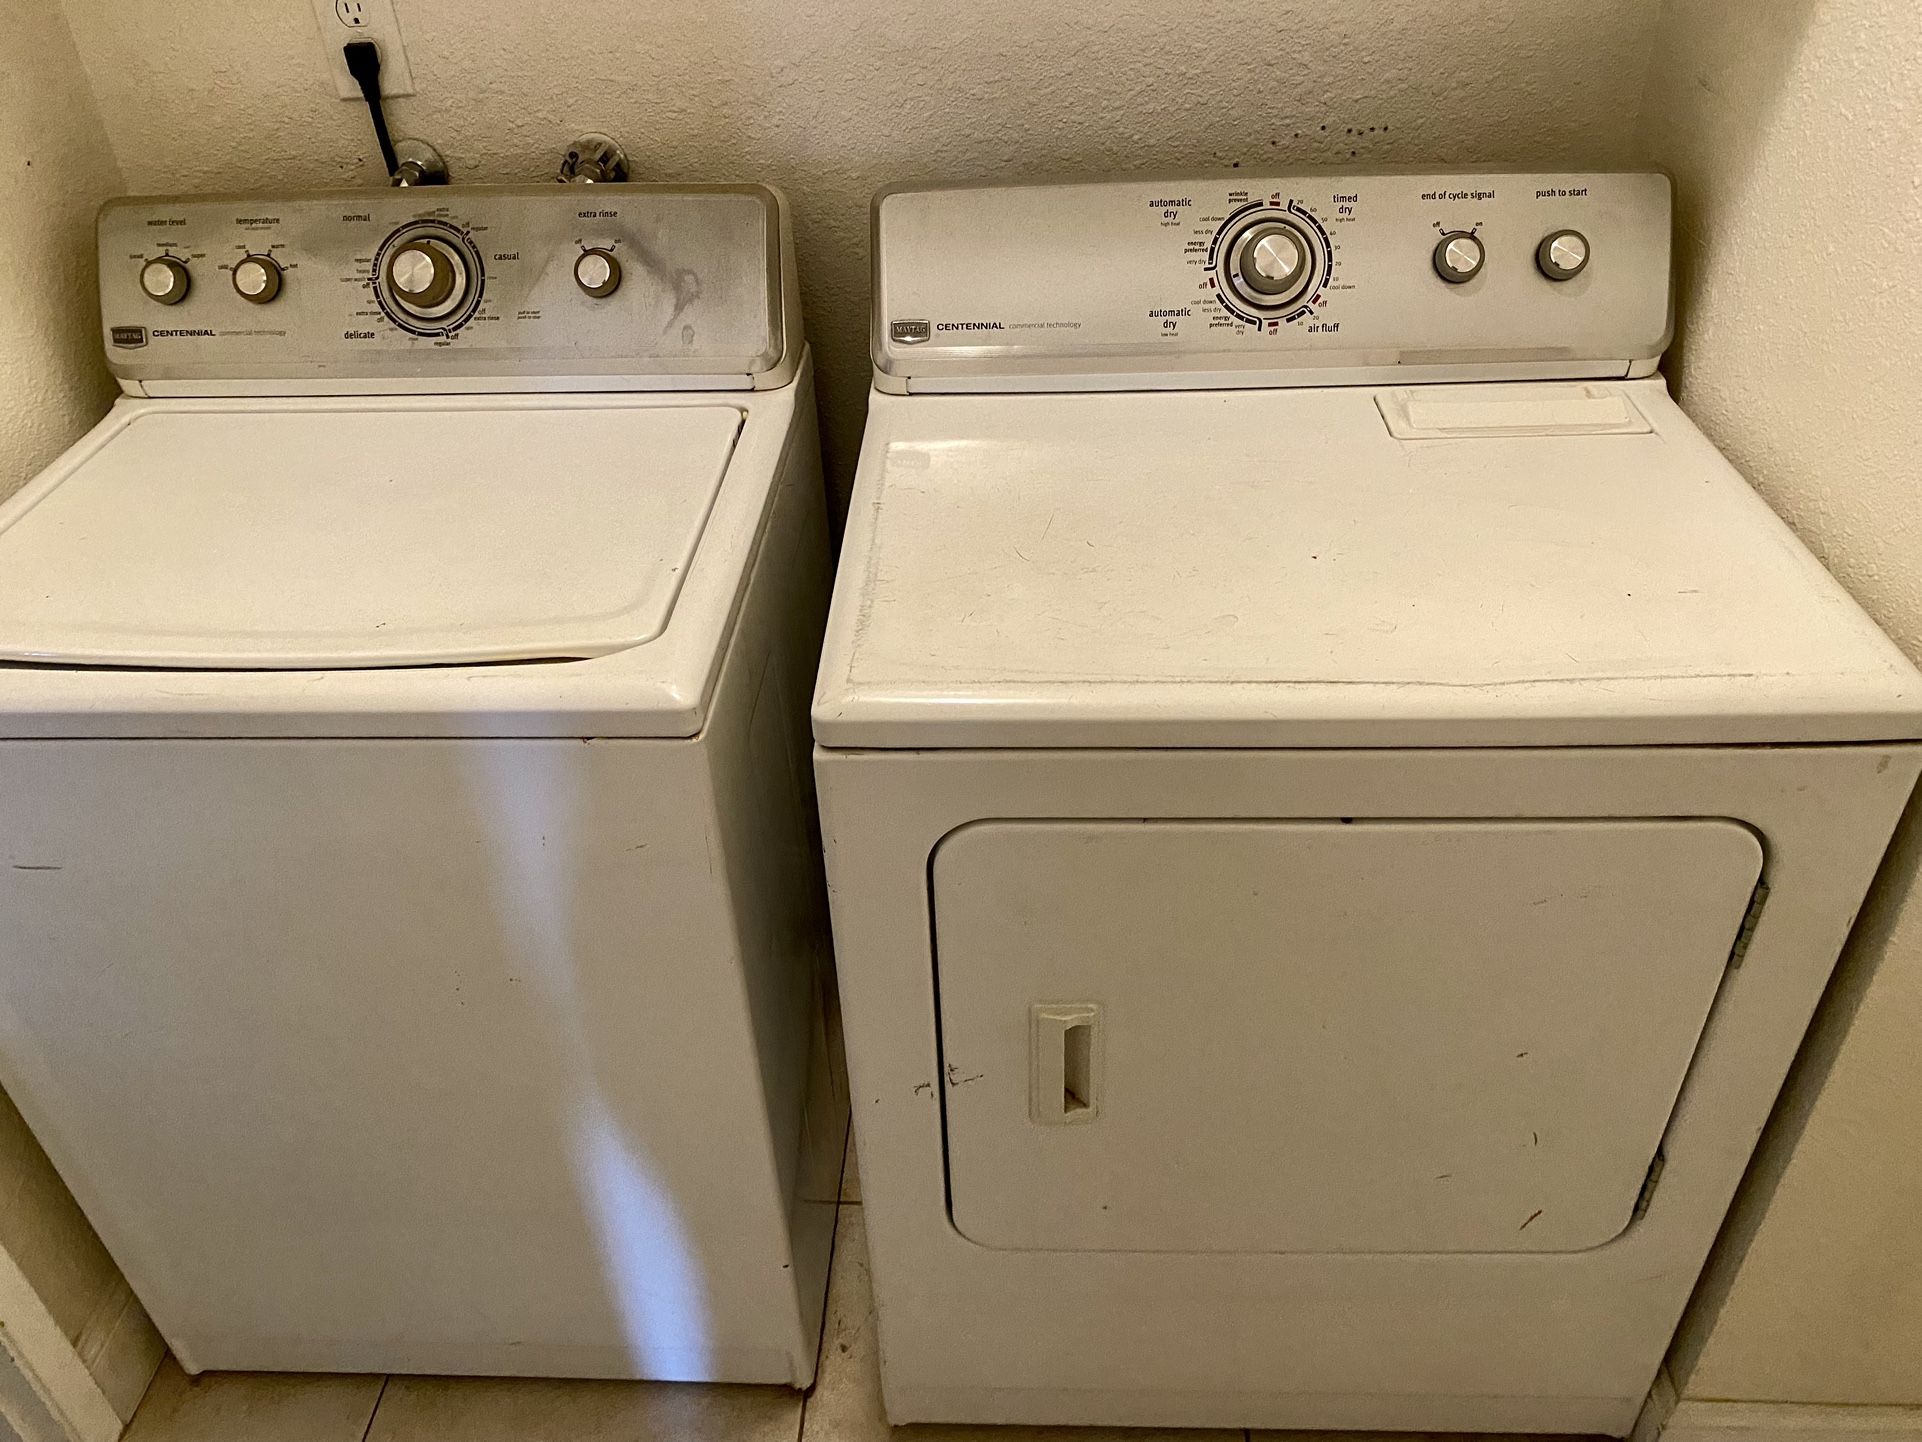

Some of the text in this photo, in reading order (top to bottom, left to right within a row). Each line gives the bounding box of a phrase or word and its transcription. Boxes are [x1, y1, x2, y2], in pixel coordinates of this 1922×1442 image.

[1271, 192, 1281, 200] off
[1333, 193, 1358, 203] timed
[1421, 190, 1495, 201] end of cycle signal
[1535, 188, 1588, 199] push to start
[1149, 197, 1192, 208] automatic
[578, 209, 618, 218] extra rinse
[1163, 209, 1178, 220] dry
[1338, 204, 1354, 216] dry
[168, 218, 187, 226] level
[235, 217, 280, 227] temperature
[342, 214, 371, 222] normal
[1184, 246, 1209, 254] preferred
[493, 252, 520, 261] casual
[1199, 281, 1208, 289] off
[1317, 300, 1328, 308] off
[1148, 307, 1192, 318] automatic
[895, 325, 926, 334] MAYTAG
[936, 322, 1005, 331] CENTENNIAL
[1046, 321, 1082, 330] technology
[1163, 319, 1178, 331] dry
[1209, 321, 1234, 329] preferred
[1307, 322, 1340, 333] air fluff
[152, 329, 216, 337] CENTENNIAL
[254, 329, 287, 337] technology
[344, 331, 375, 339] delicate
[1268, 328, 1278, 336] off
